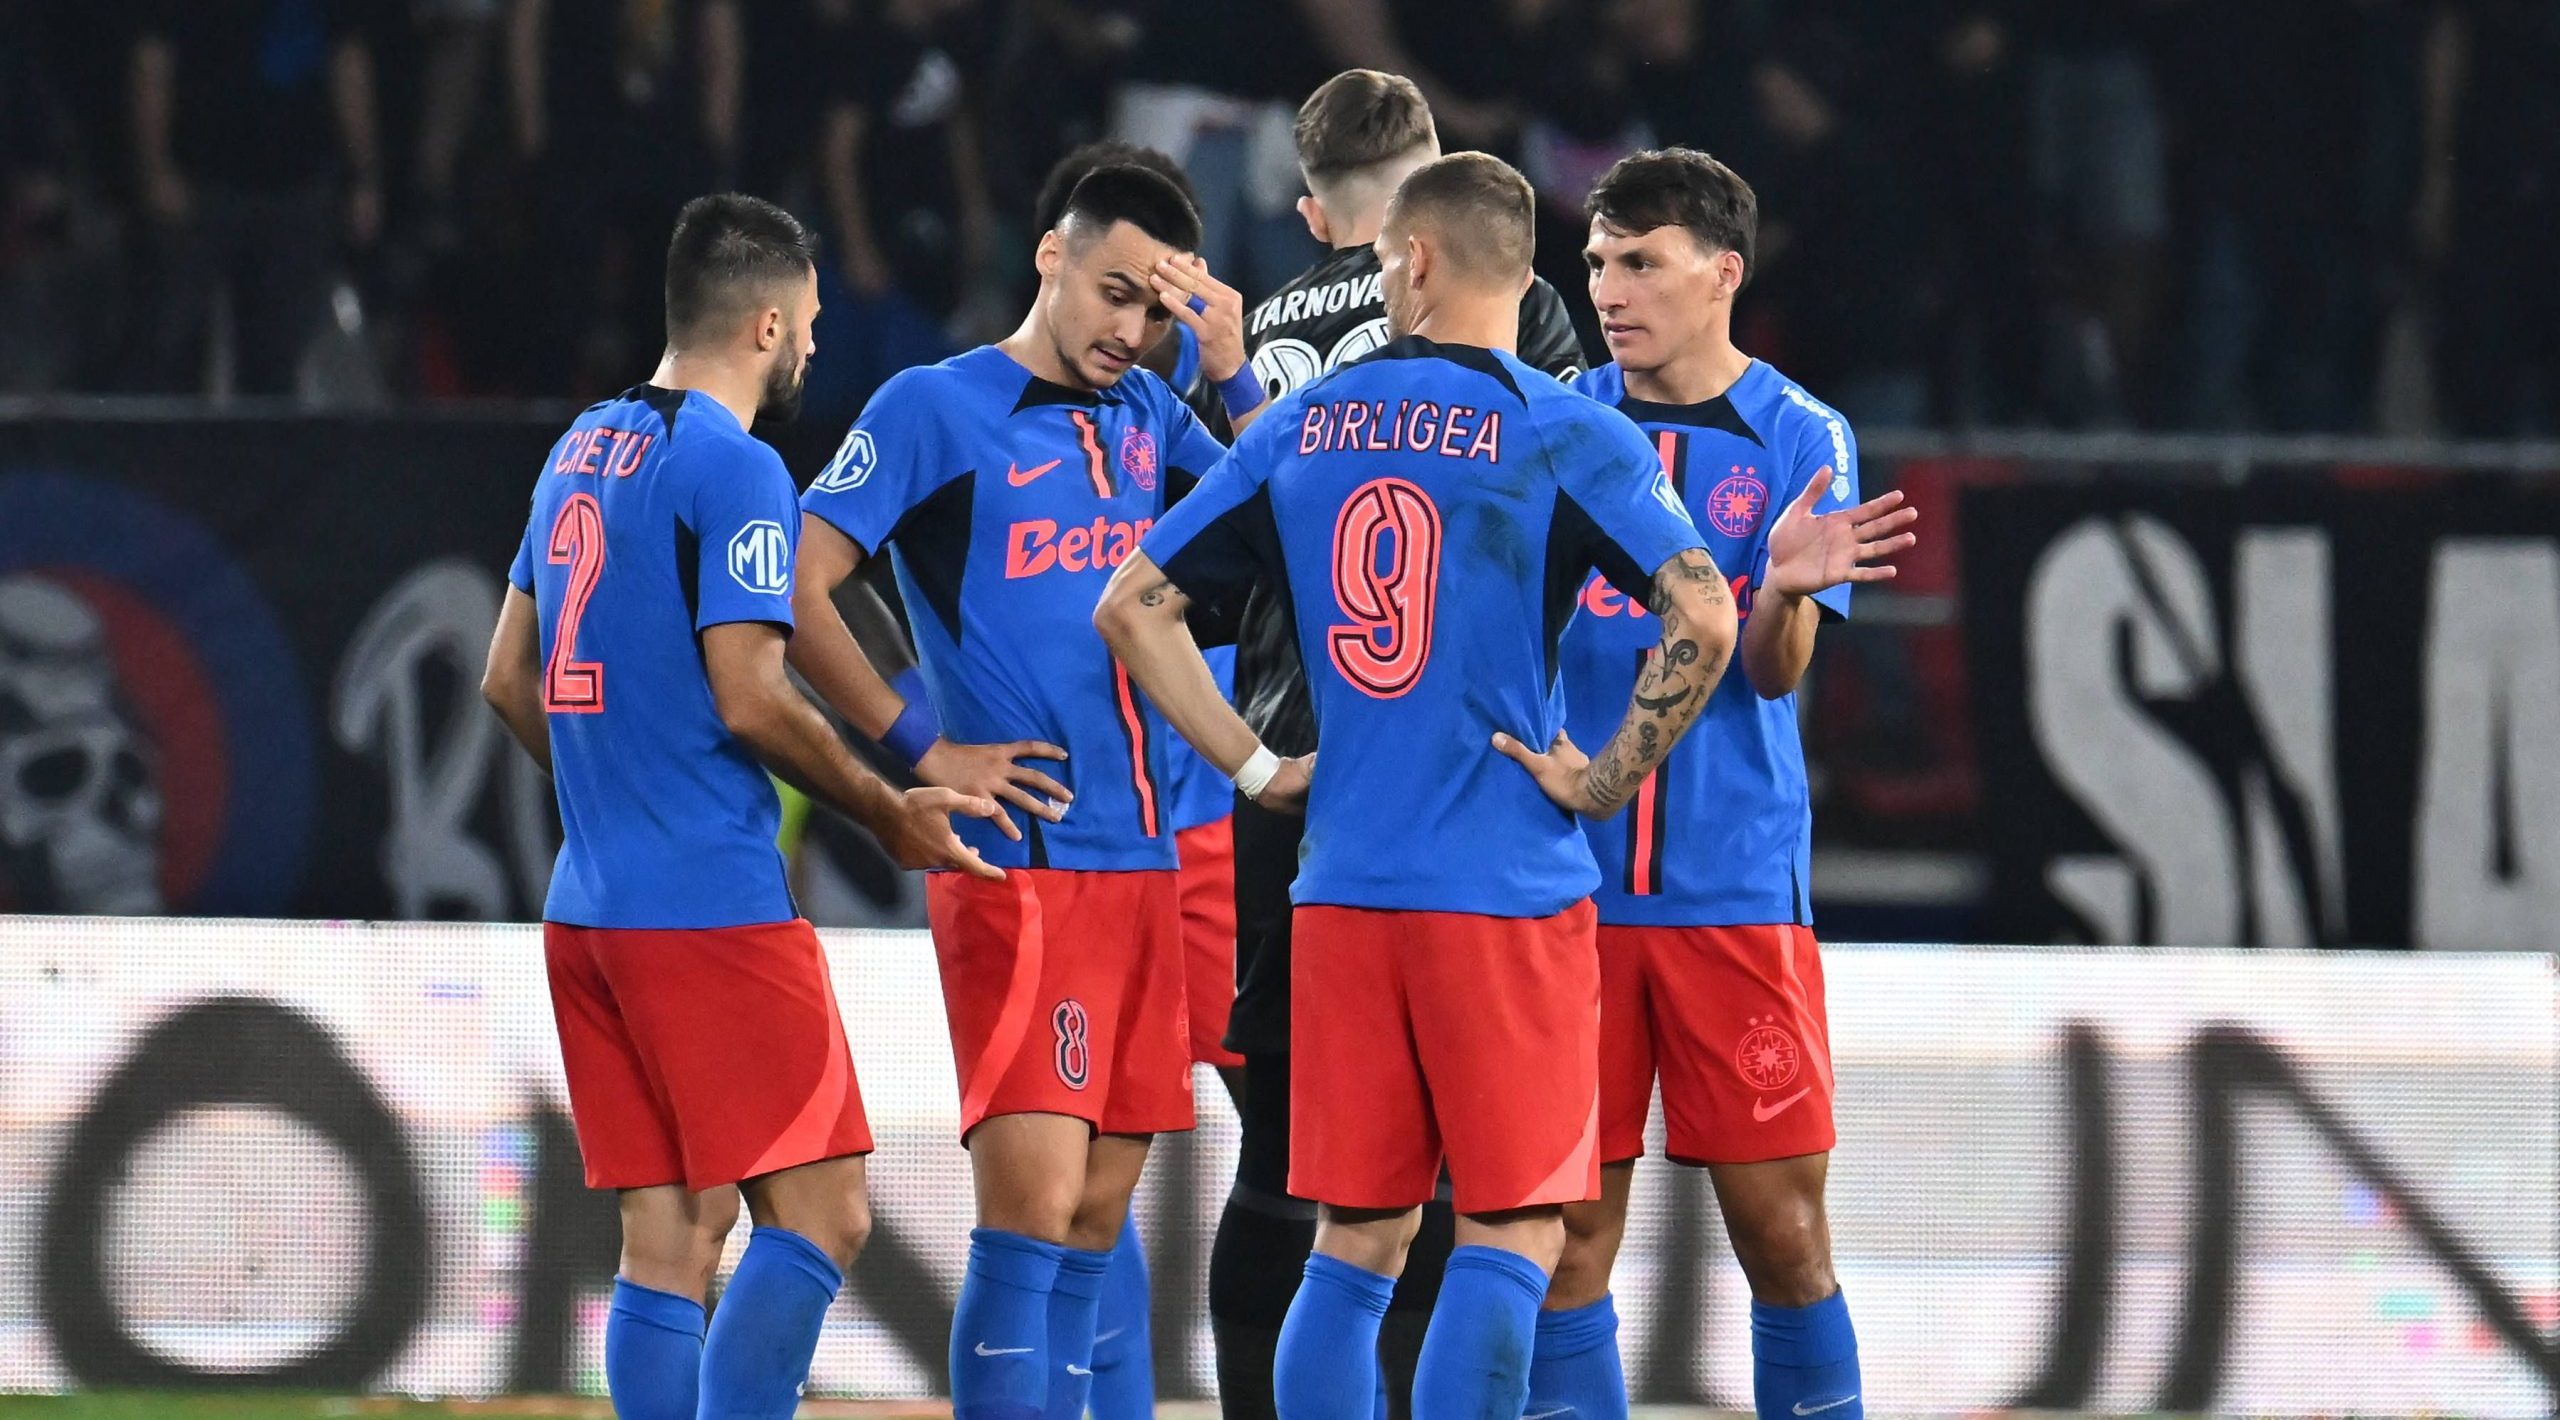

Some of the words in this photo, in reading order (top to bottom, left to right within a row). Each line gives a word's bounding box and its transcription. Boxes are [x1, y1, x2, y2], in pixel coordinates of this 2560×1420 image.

[1299, 400, 1500, 465] BIRLIGEA
[545, 493, 604, 713] 2
[1328, 477, 1442, 699] 9
[1050, 998, 1090, 1091] 8
